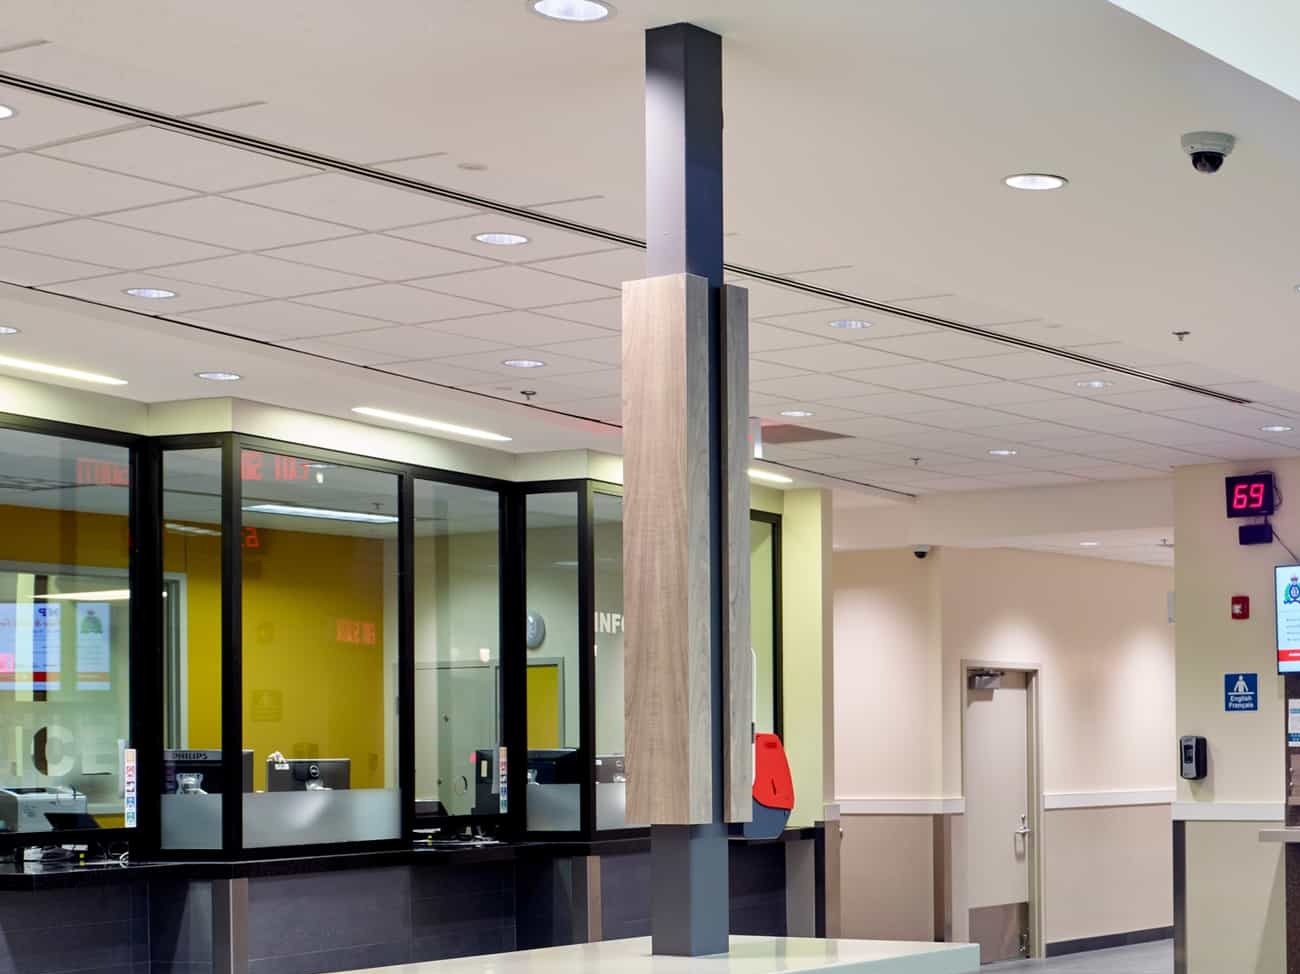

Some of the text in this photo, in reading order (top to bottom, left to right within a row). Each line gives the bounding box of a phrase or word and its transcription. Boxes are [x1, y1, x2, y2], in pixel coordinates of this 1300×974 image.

[1233, 483, 1265, 509] 69
[1230, 695, 1253, 703] English
[172, 752, 209, 760] PHILIPS
